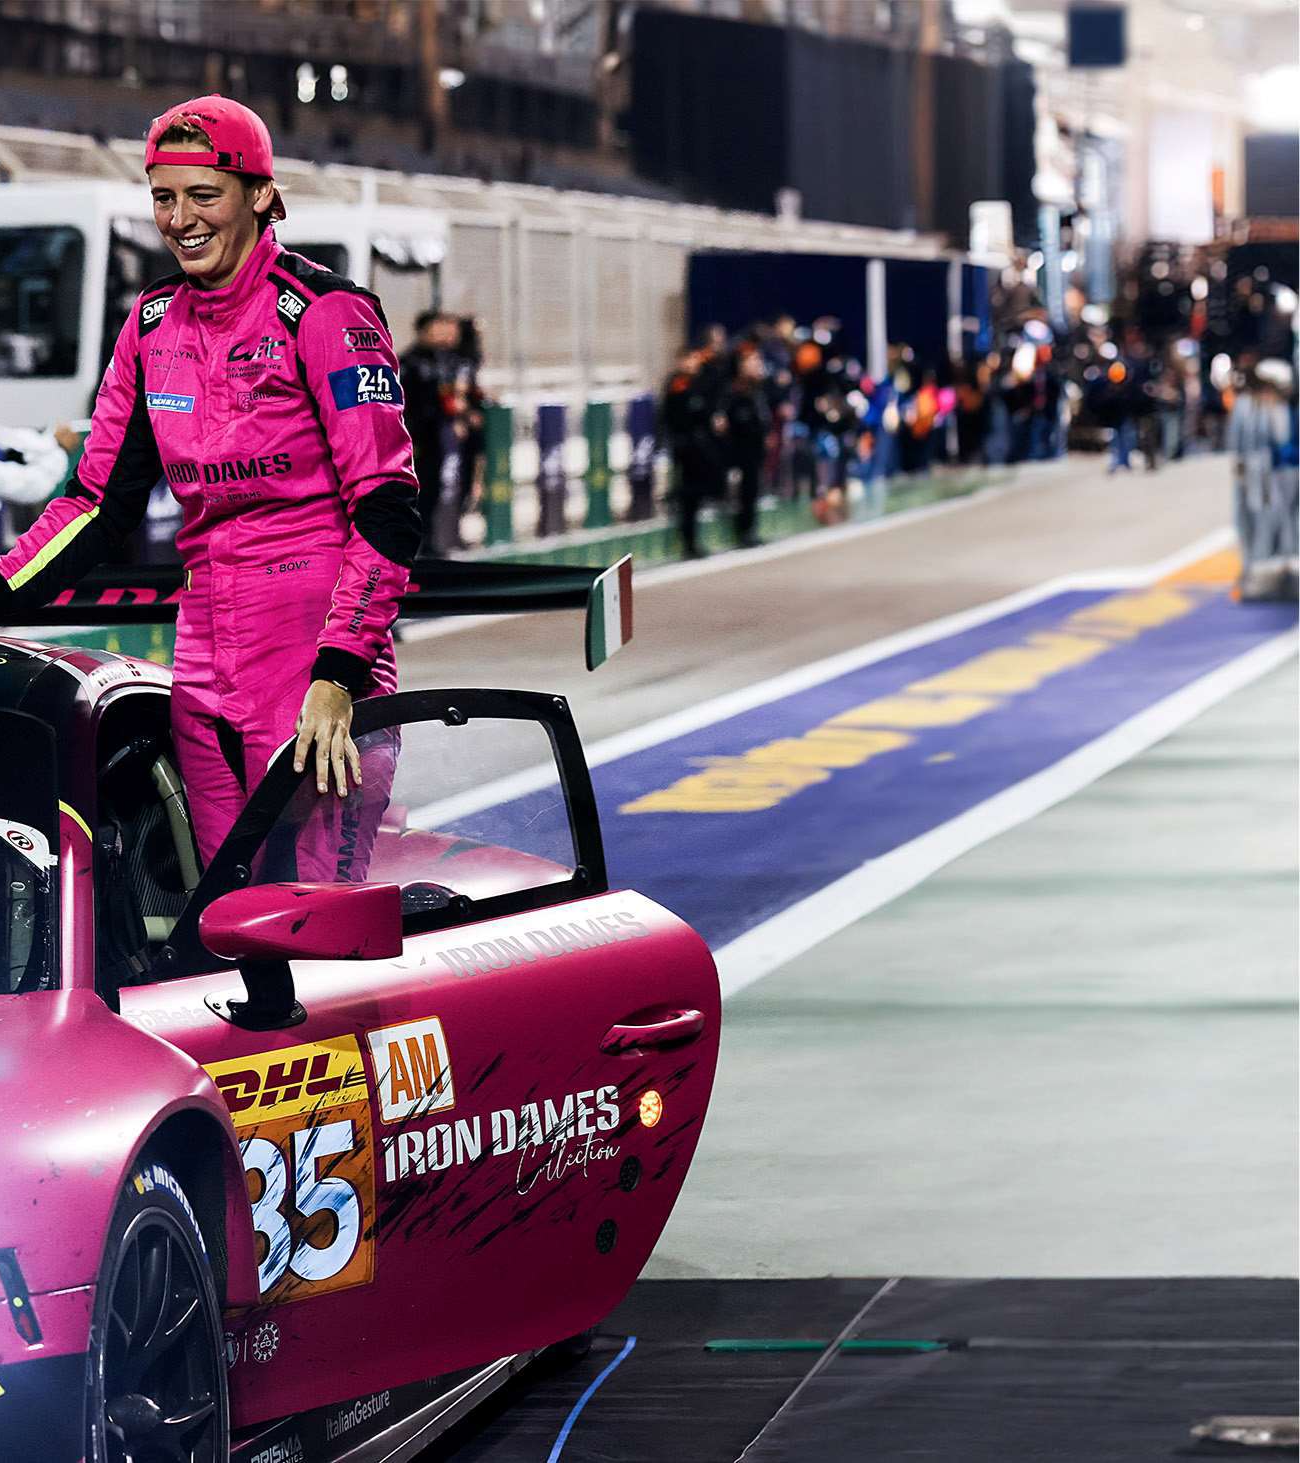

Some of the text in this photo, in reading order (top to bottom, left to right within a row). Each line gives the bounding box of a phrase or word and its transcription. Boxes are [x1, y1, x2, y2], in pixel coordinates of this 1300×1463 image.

[278, 294, 303, 317] OMP
[343, 331, 382, 348] OMP
[357, 367, 390, 393] 24h
[357, 392, 393, 403] LE MANS
[166, 452, 292, 485] IRON DAMES
[265, 560, 311, 575] S. BOVY
[436, 911, 651, 978] IRON DAMES
[215, 1053, 343, 1113] DHL
[388, 1033, 444, 1106] AM
[382, 1085, 621, 1183] IRON DAMES
[325, 1390, 390, 1441] ItalianGesture
